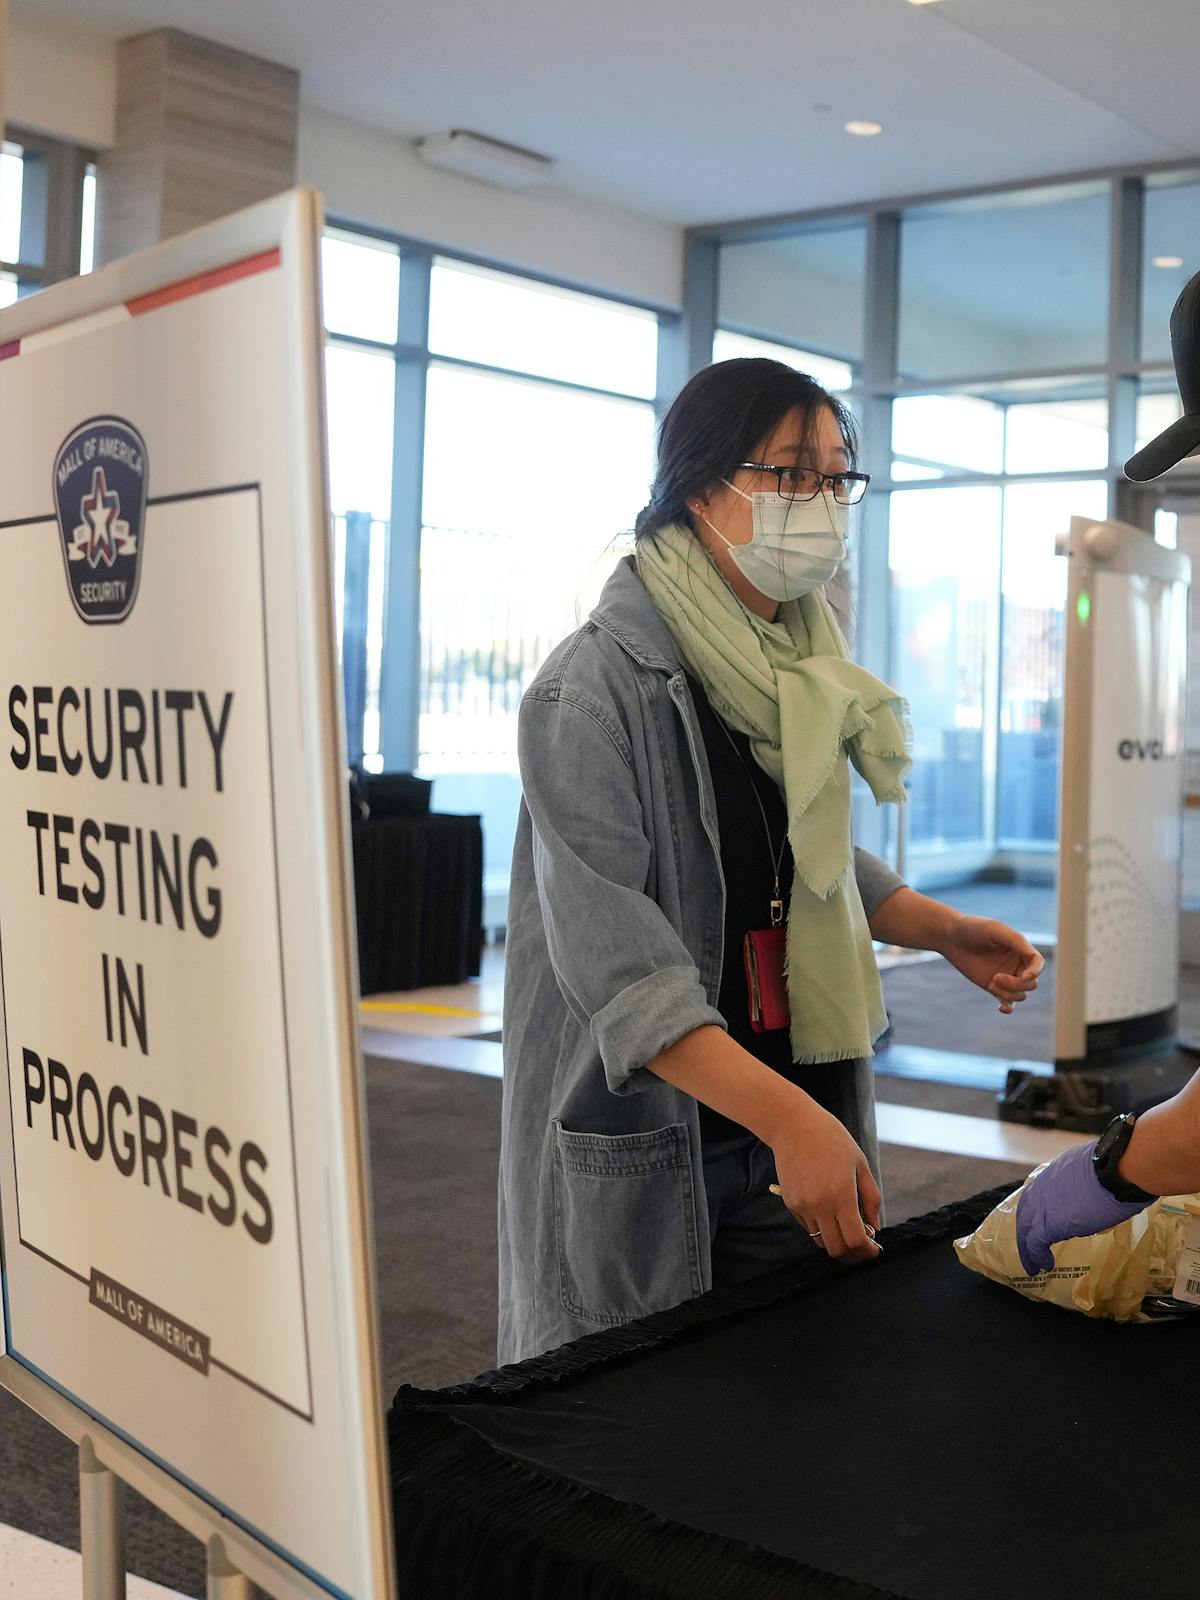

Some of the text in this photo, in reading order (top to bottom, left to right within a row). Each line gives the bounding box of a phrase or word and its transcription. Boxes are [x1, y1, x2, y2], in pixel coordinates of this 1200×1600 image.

[57, 437, 143, 486] MALL OF AMERICA
[80, 580, 127, 604] SECURITY
[8, 684, 235, 793] SECURITY
[26, 810, 223, 939] TESTING
[101, 952, 149, 1057] IN
[22, 1046, 274, 1245] PROGRESS
[95, 1280, 204, 1364] MALL OF AMERICA
